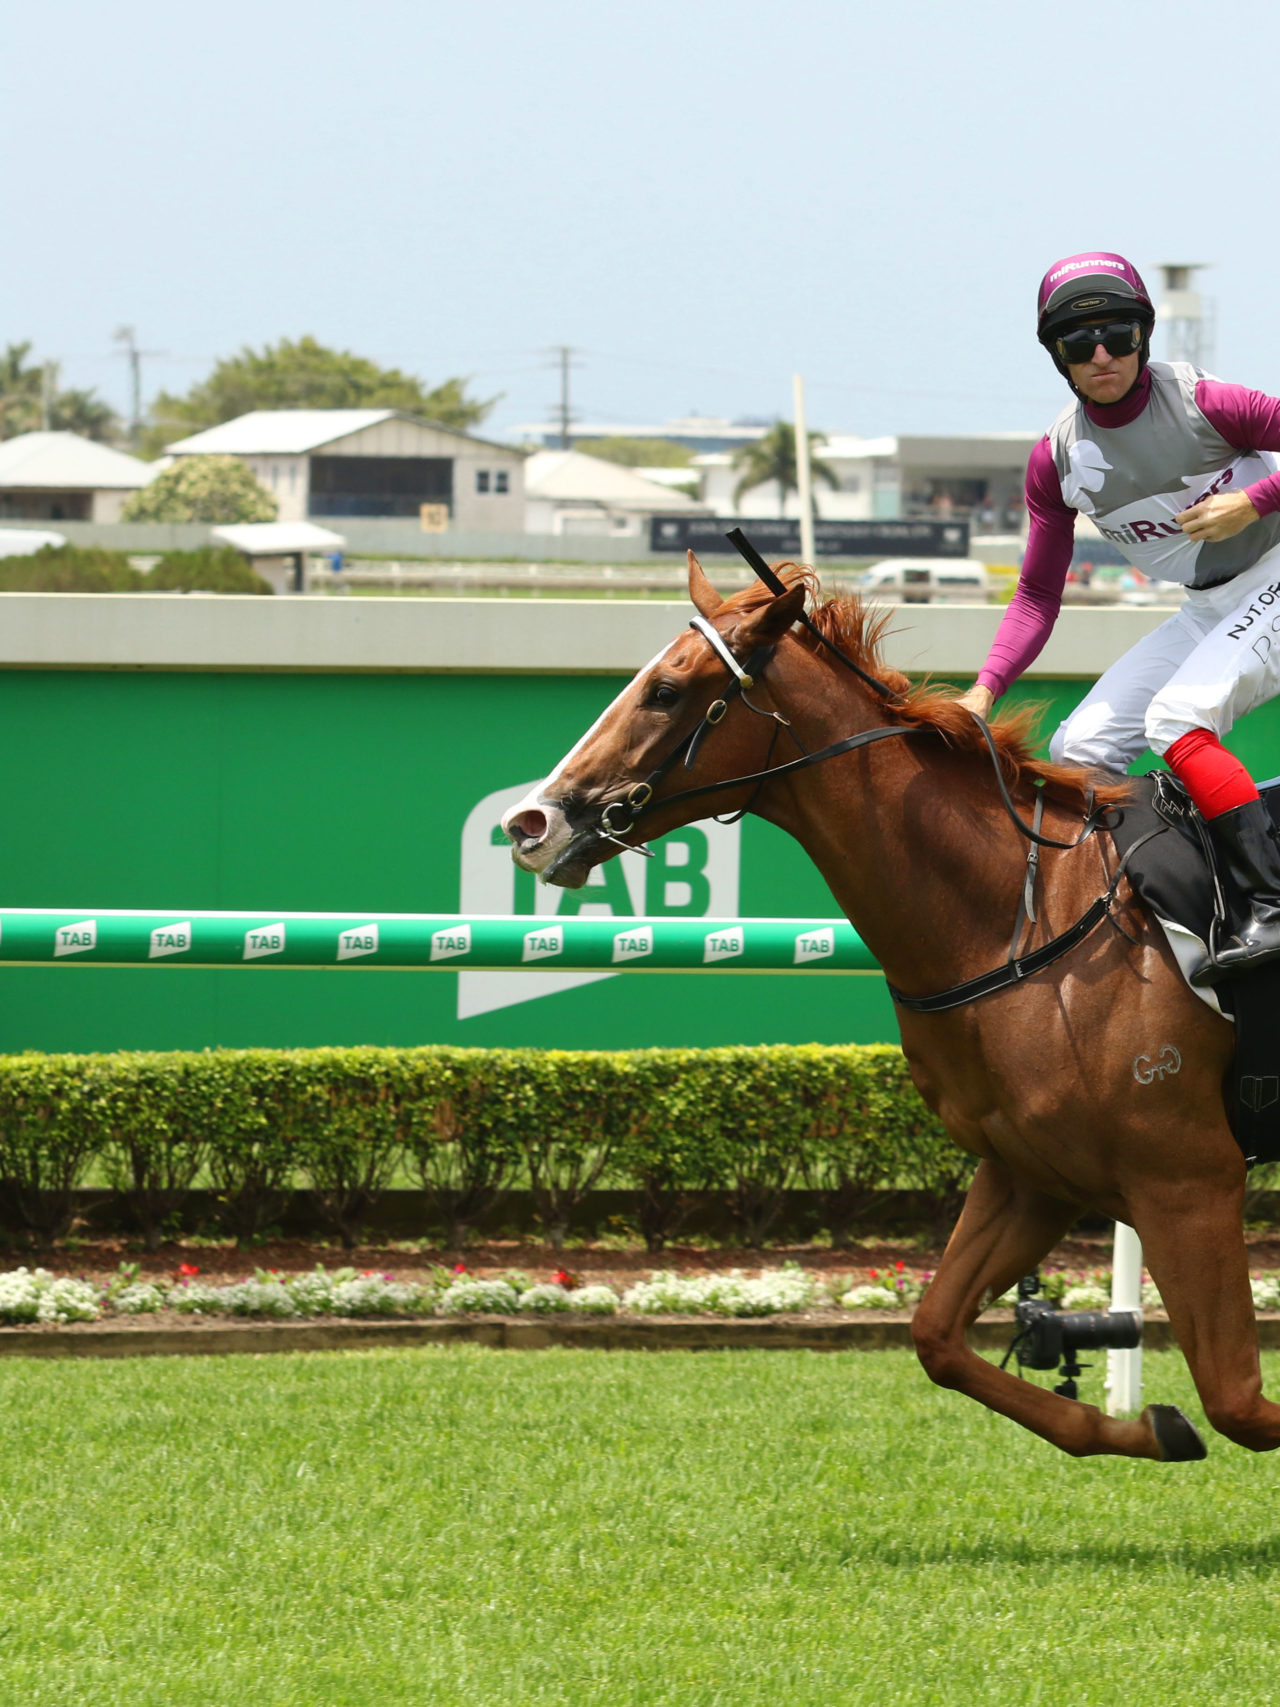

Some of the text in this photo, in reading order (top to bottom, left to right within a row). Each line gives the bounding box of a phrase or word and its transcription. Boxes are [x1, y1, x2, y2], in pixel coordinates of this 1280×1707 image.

[61, 932, 92, 946] TAB
[155, 933, 187, 948] TAB
[249, 935, 281, 949] TAB
[343, 936, 375, 950] TAB
[436, 936, 467, 950] TAB
[529, 937, 559, 951] TAB
[618, 938, 649, 952] TAB
[709, 938, 740, 952] TAB
[800, 939, 830, 953] TAB
